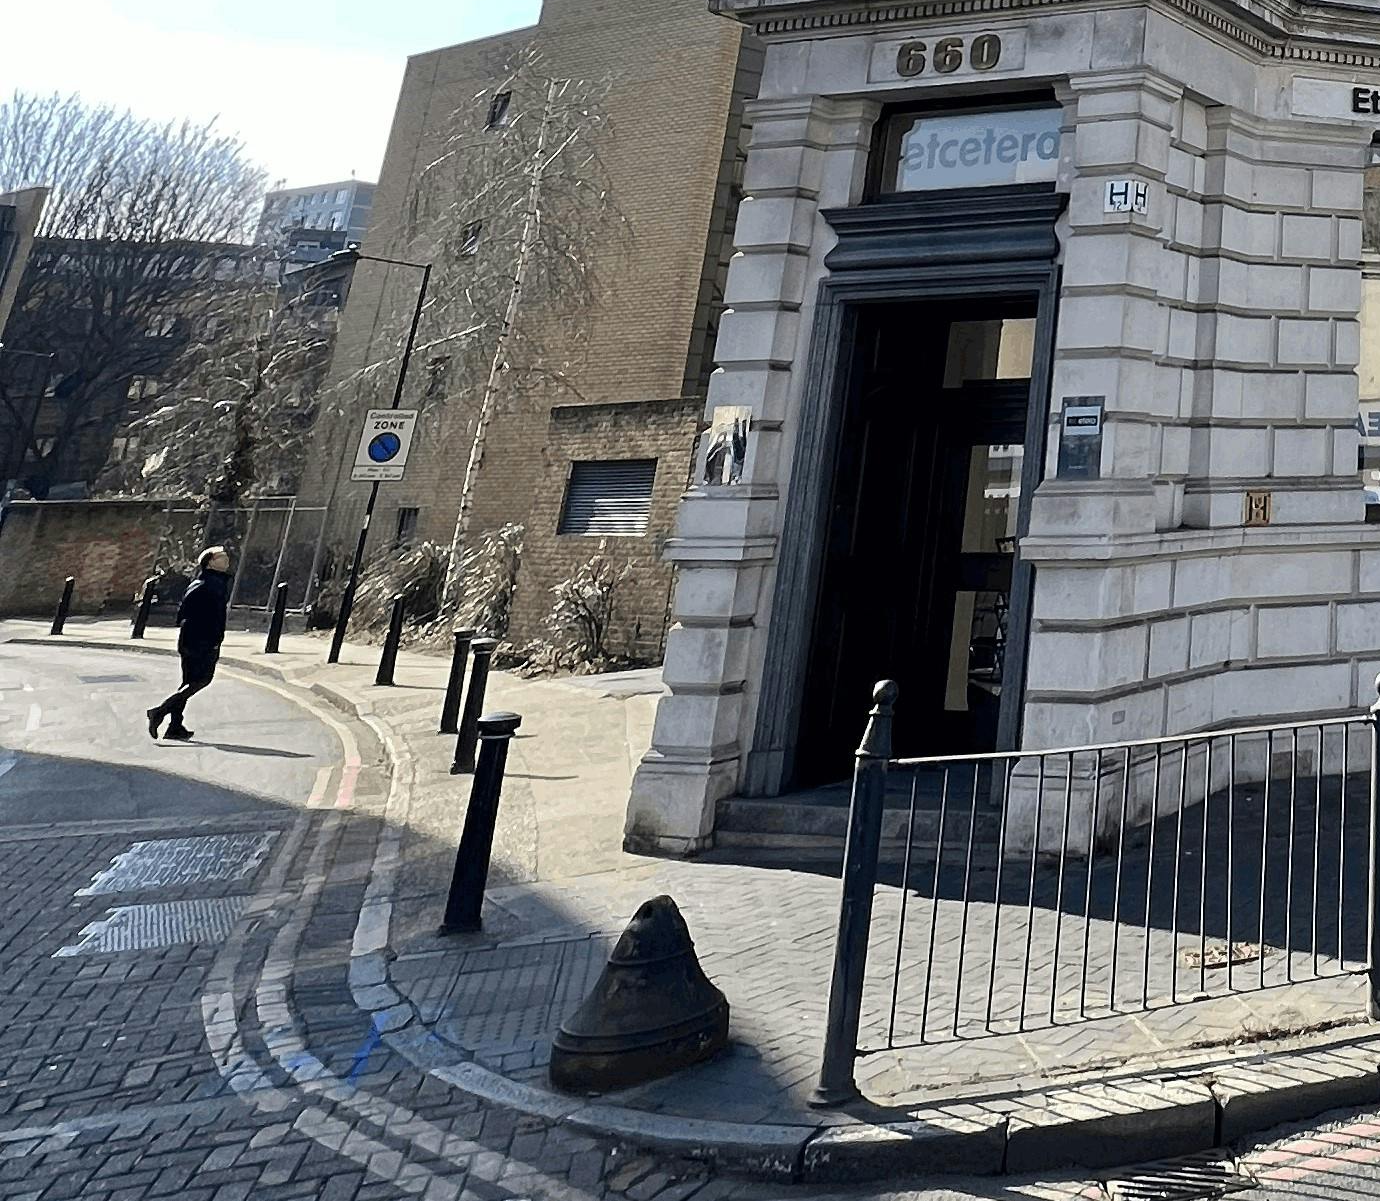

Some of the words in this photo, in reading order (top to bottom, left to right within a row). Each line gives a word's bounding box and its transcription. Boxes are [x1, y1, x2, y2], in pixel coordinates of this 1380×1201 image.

[896, 34, 1001, 77] 660
[904, 128, 1061, 171] etcetera
[1110, 183, 1128, 205] H
[1135, 183, 1147, 207] H
[374, 421, 405, 430] ZONE
